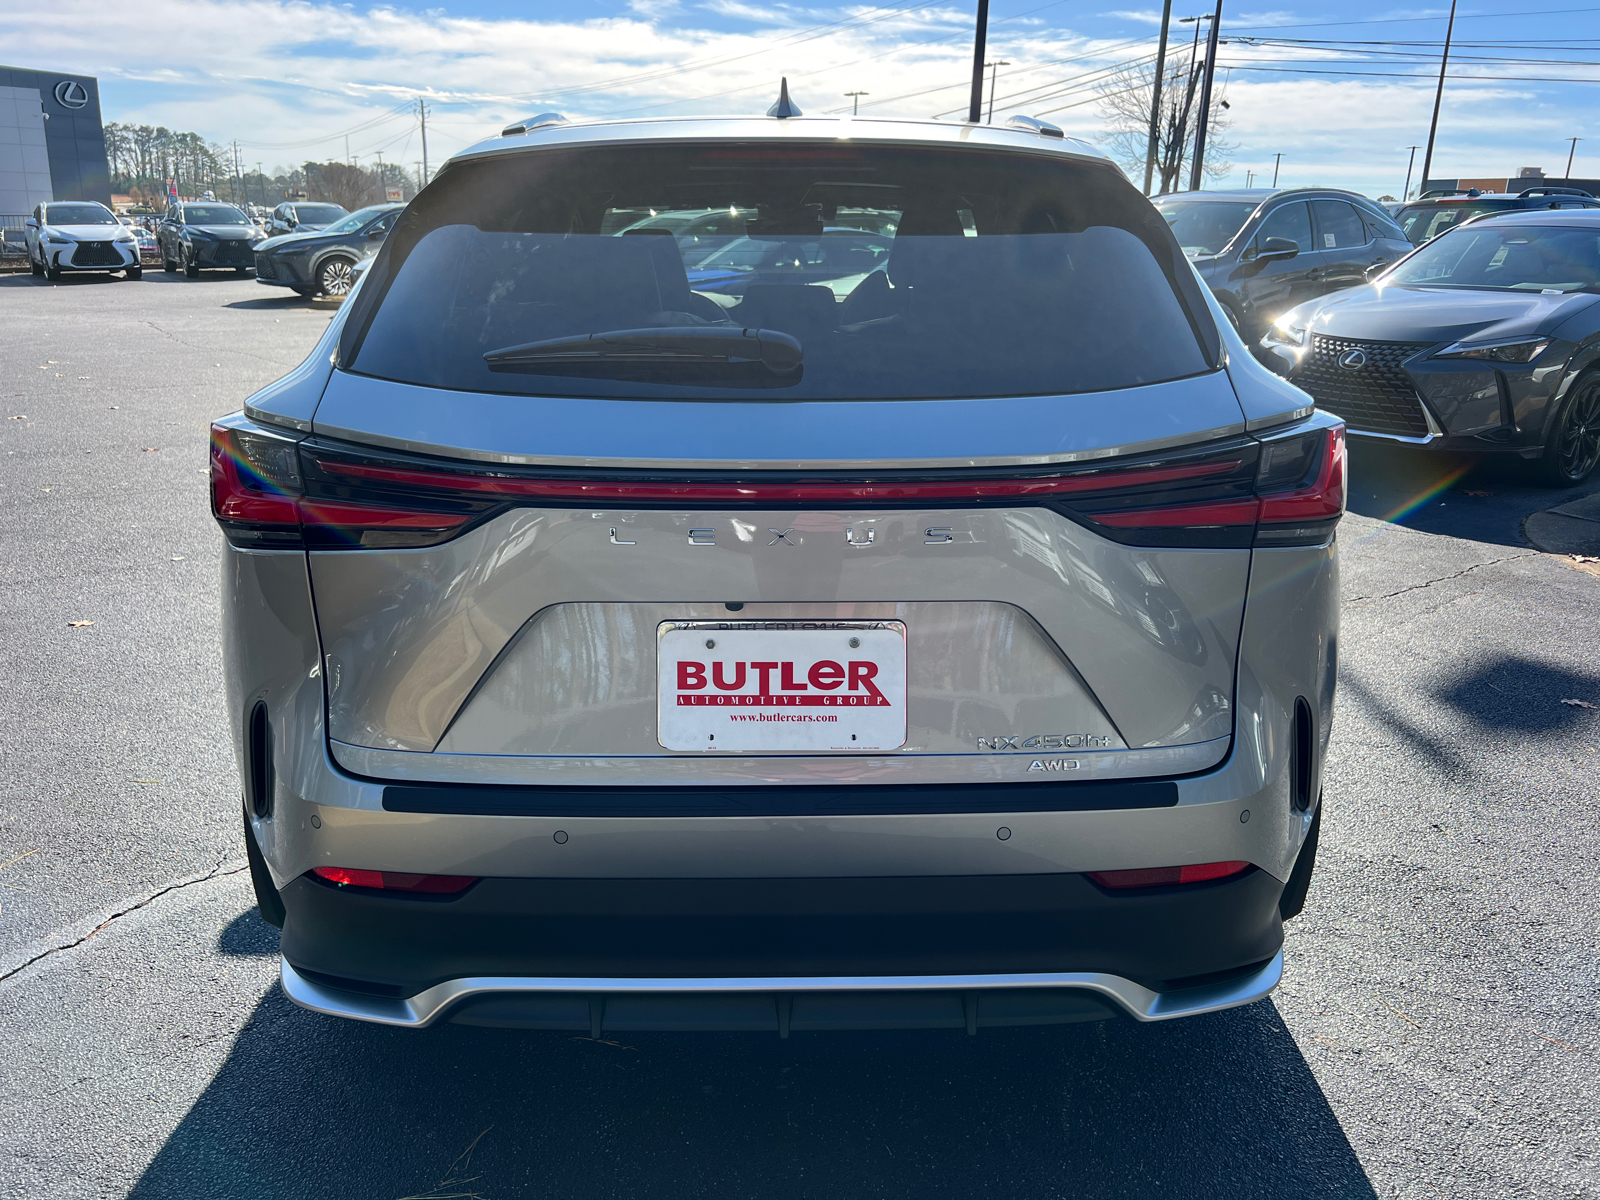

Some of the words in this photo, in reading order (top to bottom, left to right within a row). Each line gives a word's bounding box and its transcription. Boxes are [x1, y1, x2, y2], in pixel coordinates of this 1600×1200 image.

[609, 527, 953, 546] LEXUS
[678, 696, 802, 705] AUTOMOTIVE
[823, 696, 883, 705] GROUP
[730, 712, 838, 722] www.butlercars.com
[1026, 759, 1080, 771] AWD
